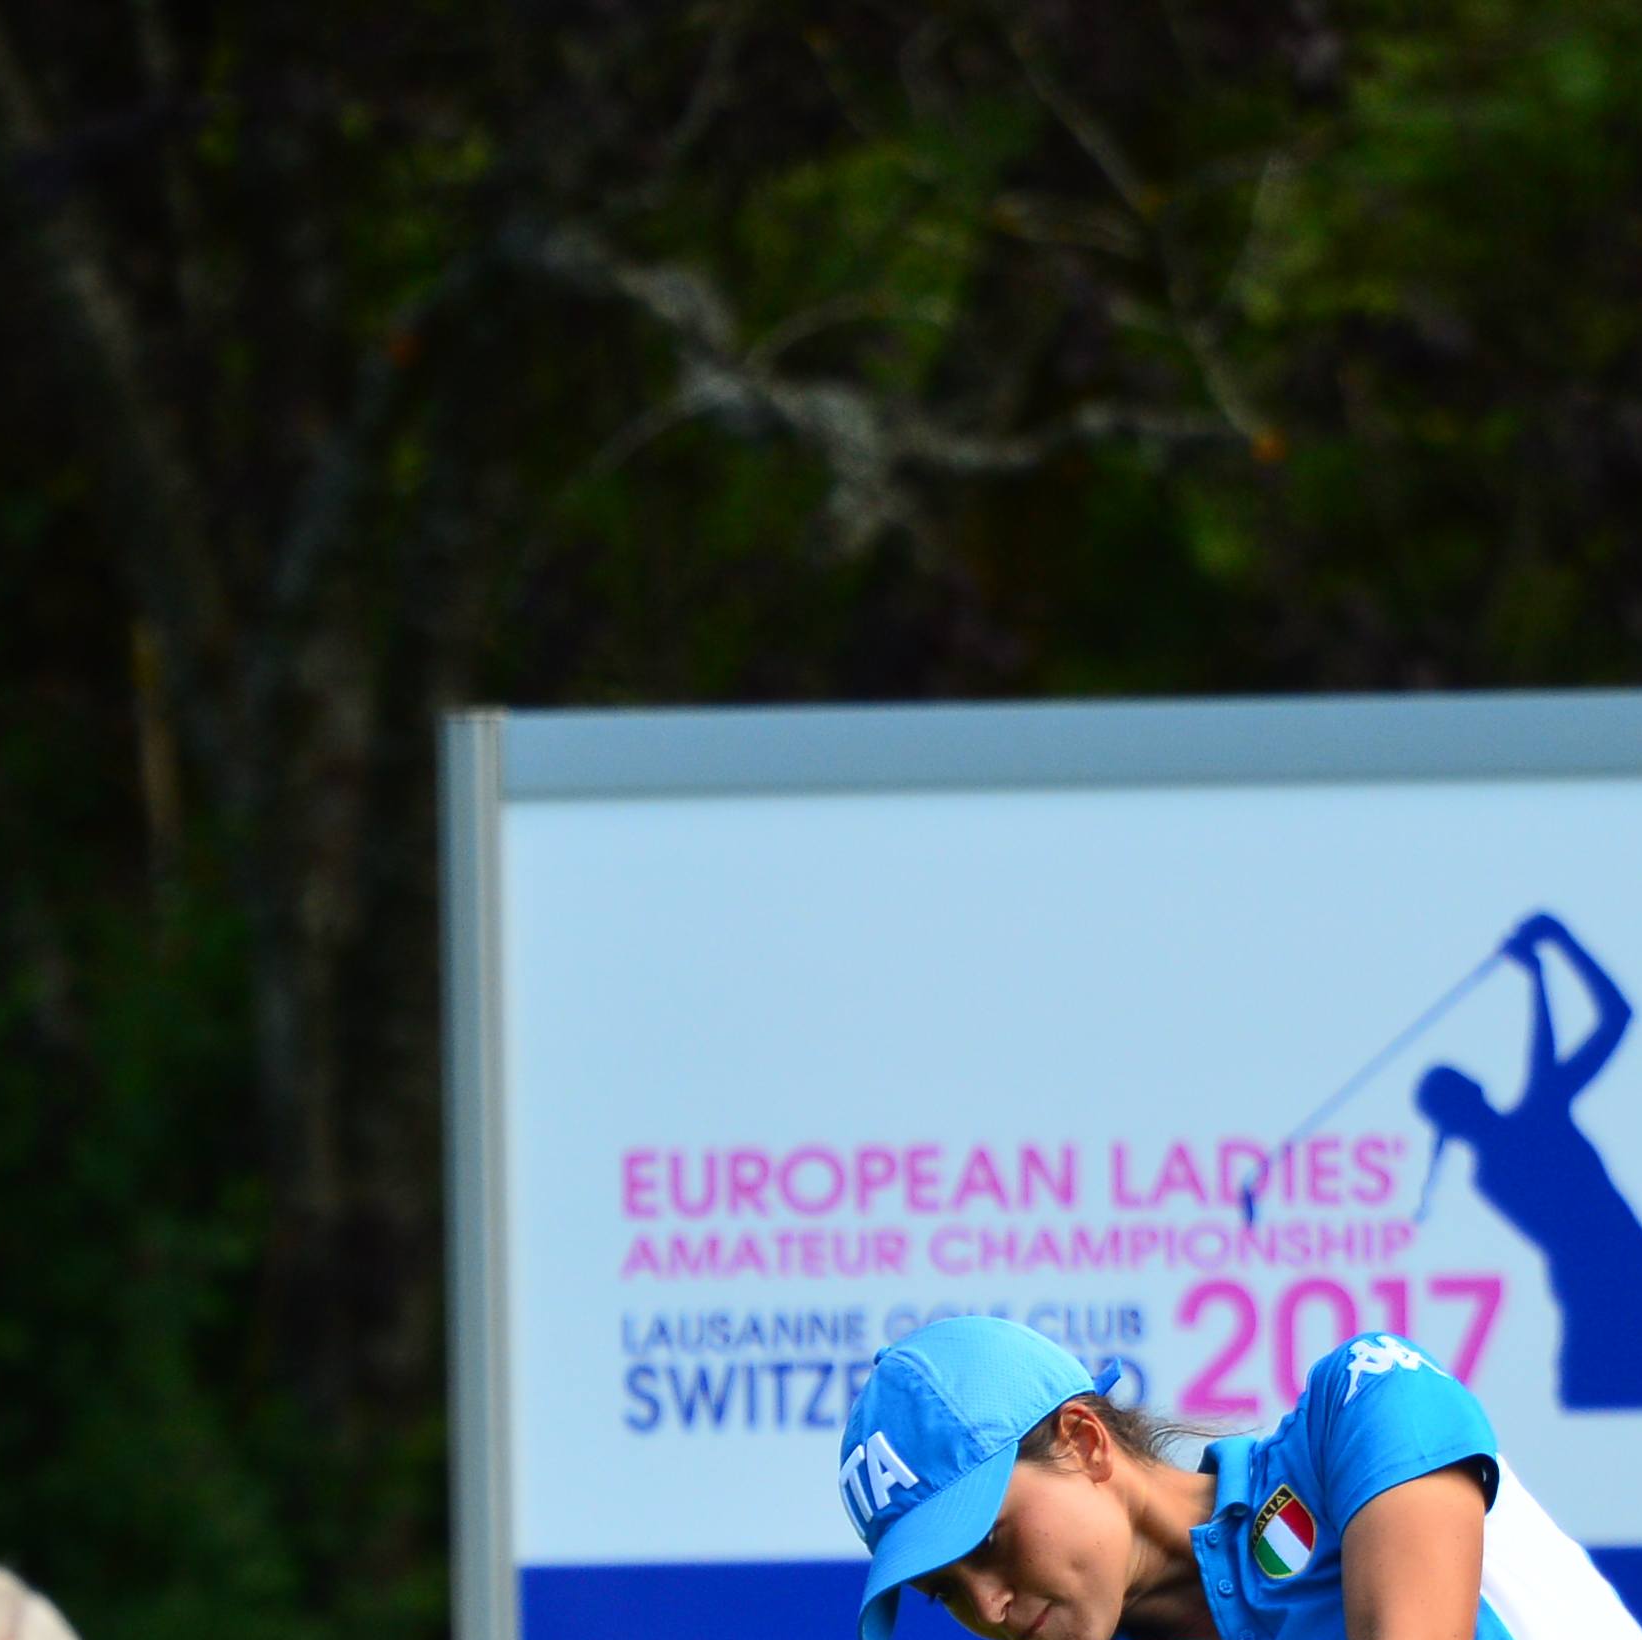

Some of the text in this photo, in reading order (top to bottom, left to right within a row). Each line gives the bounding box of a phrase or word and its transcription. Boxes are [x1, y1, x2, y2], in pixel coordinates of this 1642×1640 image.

[620, 1136, 1409, 1220] EUROPEAN LADIES'
[620, 1221, 1414, 1281] AMATEUR CHAMPIONSHIP
[621, 1307, 866, 1357] LAUSANNE
[1029, 1301, 1145, 1346] CLUB
